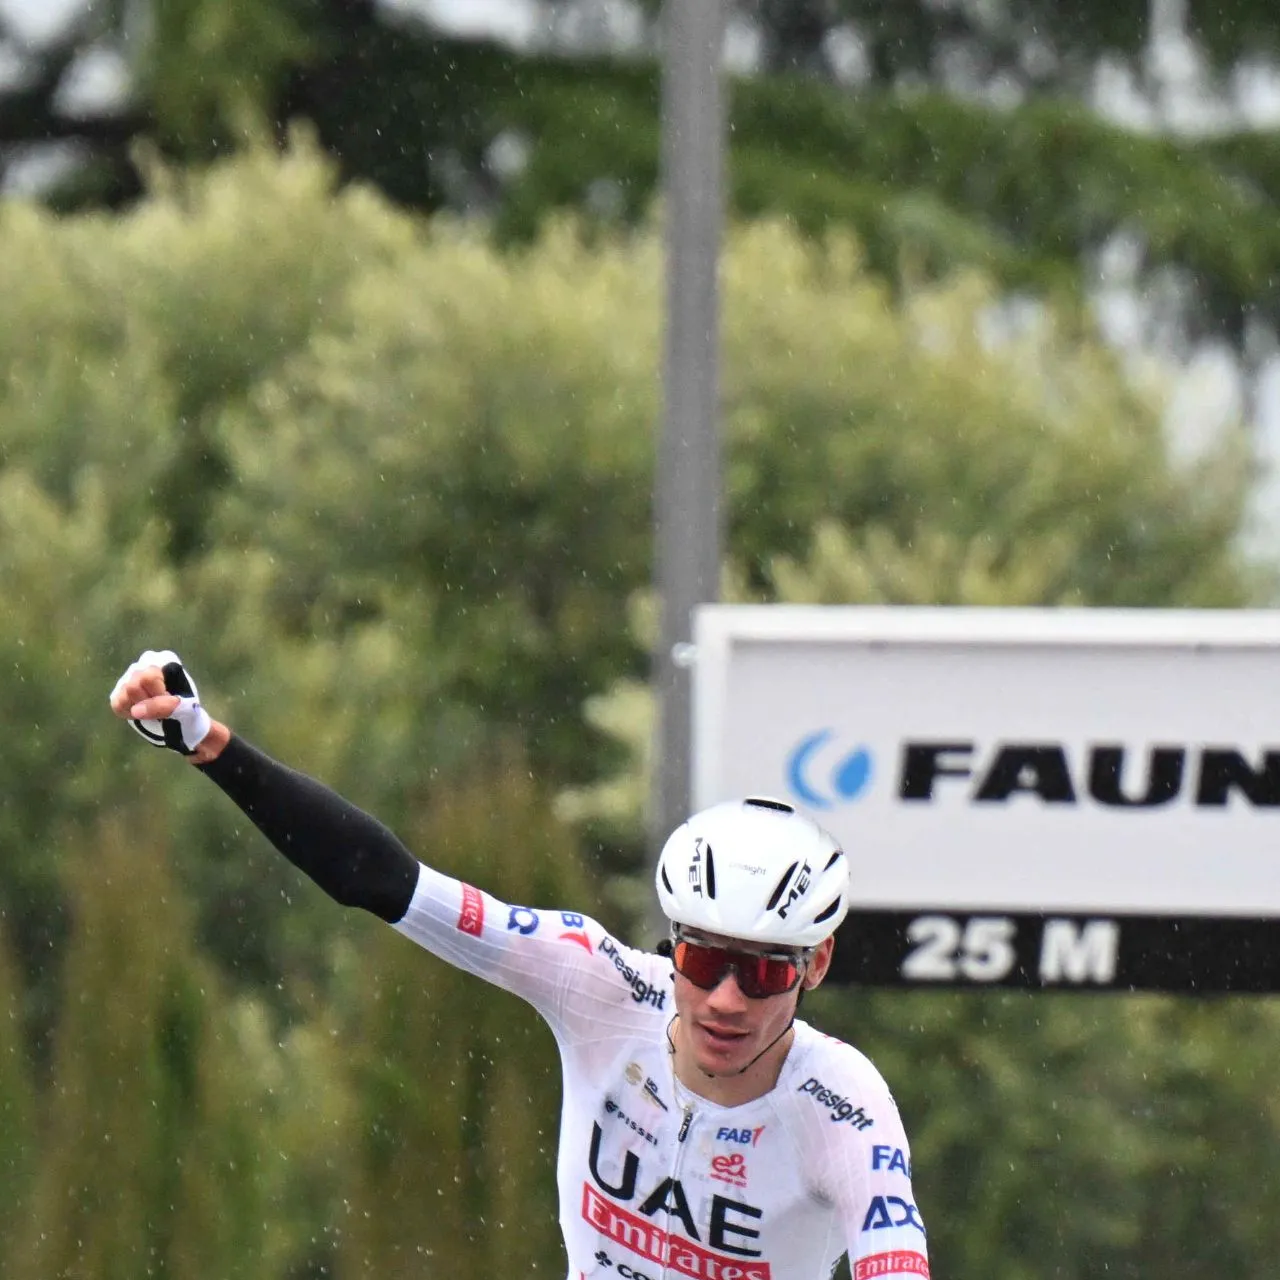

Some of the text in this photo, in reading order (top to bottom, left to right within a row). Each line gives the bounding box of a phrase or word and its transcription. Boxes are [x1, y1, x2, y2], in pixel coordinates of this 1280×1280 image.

[688, 837, 704, 900] MET
[777, 858, 813, 920] MET
[598, 935, 667, 1011] presight
[902, 917, 1119, 983] 25 M
[617, 1110, 659, 1147] PISSEI
[797, 1076, 874, 1132] presight
[588, 1119, 764, 1257] UAE
[871, 1144, 912, 1178] FA
[856, 1253, 929, 1280] Emirate
